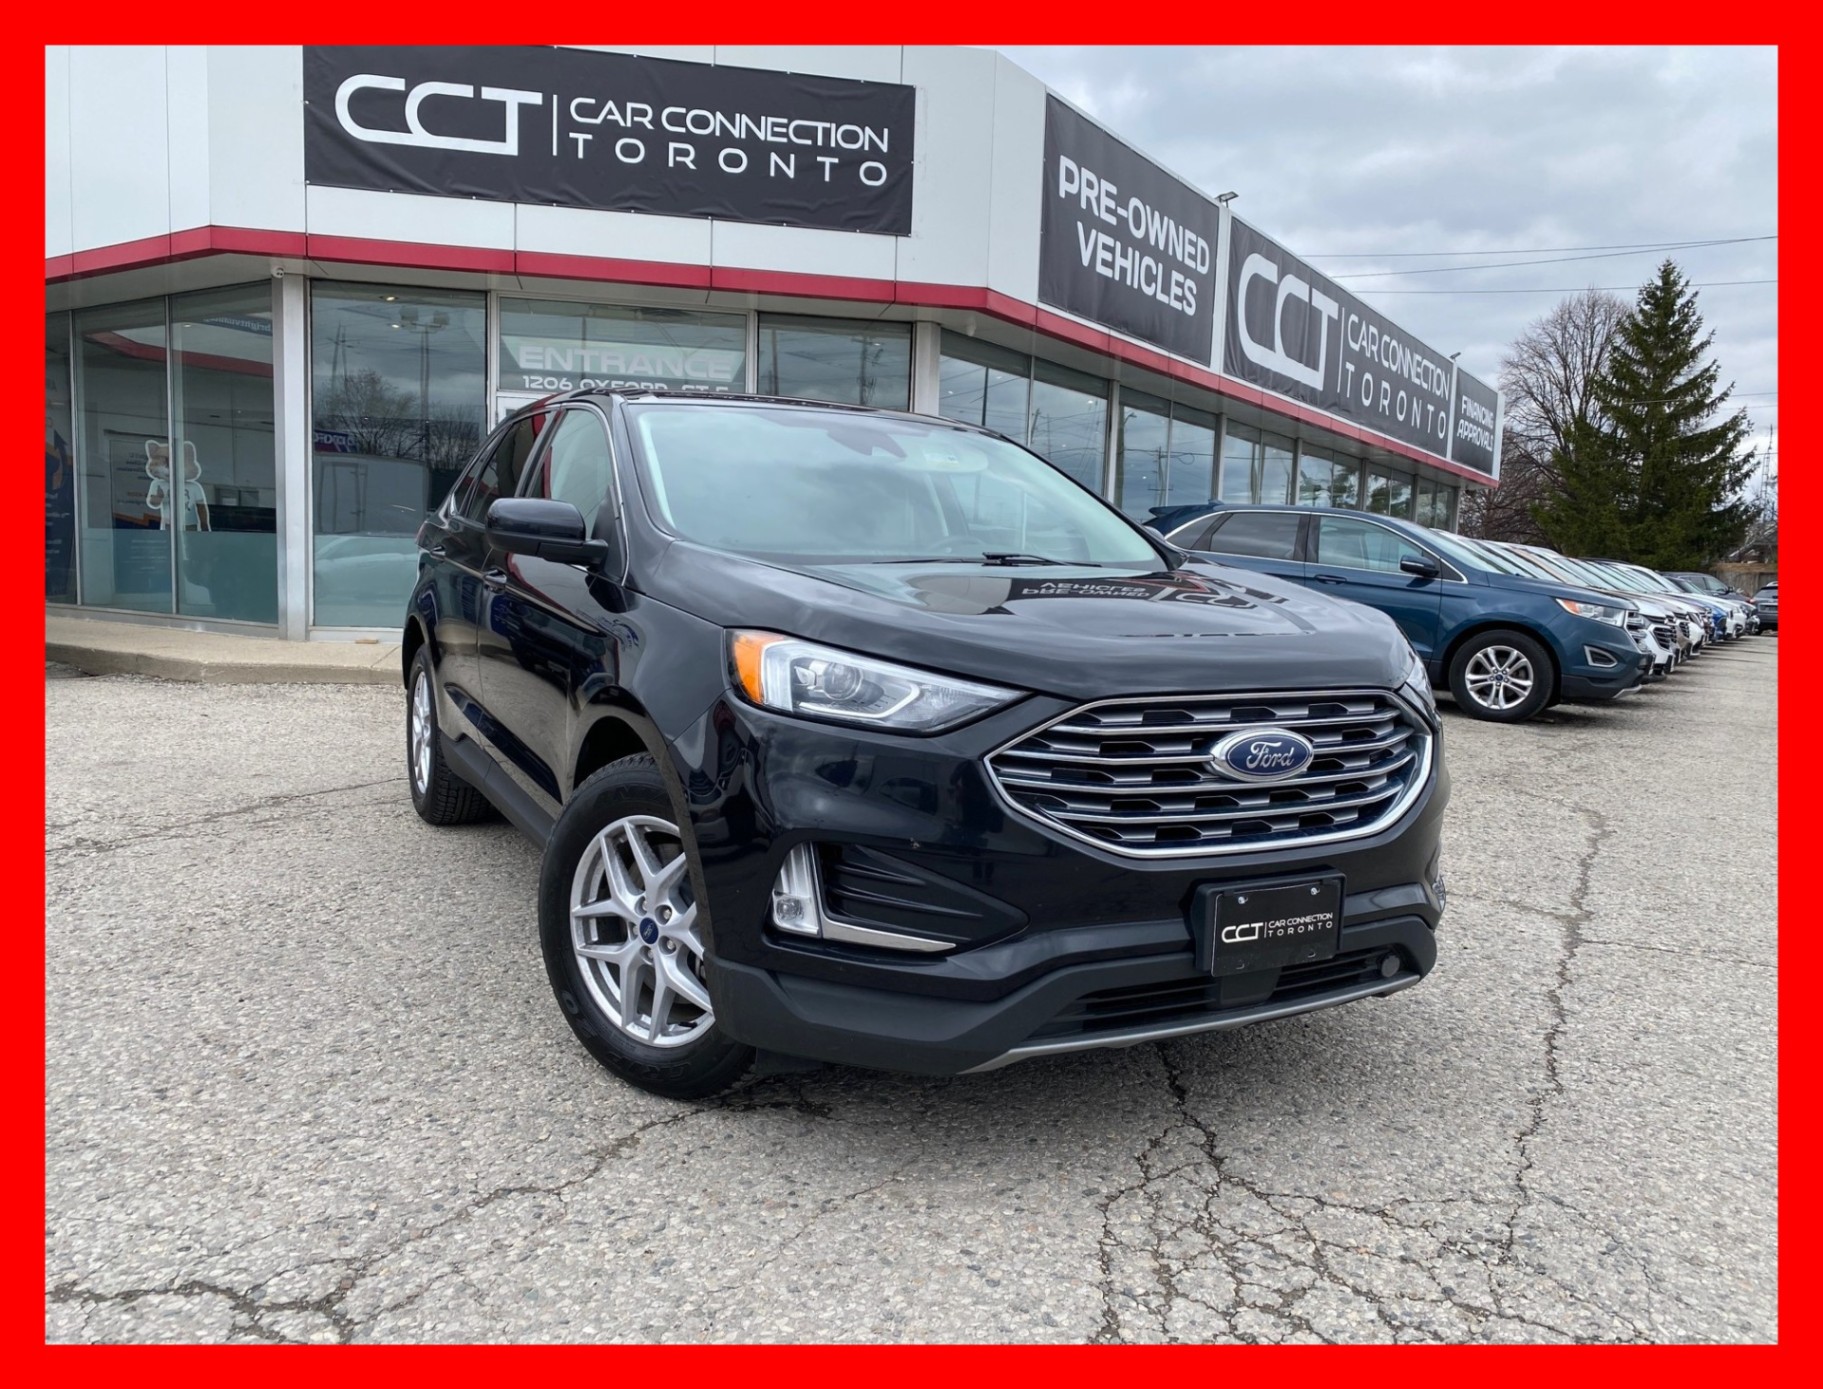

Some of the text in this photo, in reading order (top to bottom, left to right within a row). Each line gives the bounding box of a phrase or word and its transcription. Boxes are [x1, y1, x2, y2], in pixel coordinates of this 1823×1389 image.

[335, 73, 543, 157] CCT
[569, 96, 889, 153] CAR CONNECTION
[569, 132, 888, 187] TORONTO
[1059, 155, 1210, 275] PRE-OWNED
[1076, 221, 1197, 317] VEHICLES
[1237, 252, 1339, 392] CCT
[519, 346, 732, 380] ENTRANCE
[1347, 313, 1450, 401] CAR CONNECTION
[522, 375, 573, 390] 1206
[1345, 361, 1446, 439] TORONTO
[1461, 395, 1493, 429] FINANCING
[1457, 419, 1493, 452] APPROVALS
[1246, 741, 1295, 769] Ford
[1221, 922, 1264, 943] CCT
[1268, 912, 1333, 929] CAR CONNECTION
[1268, 921, 1333, 937] TORONTO
